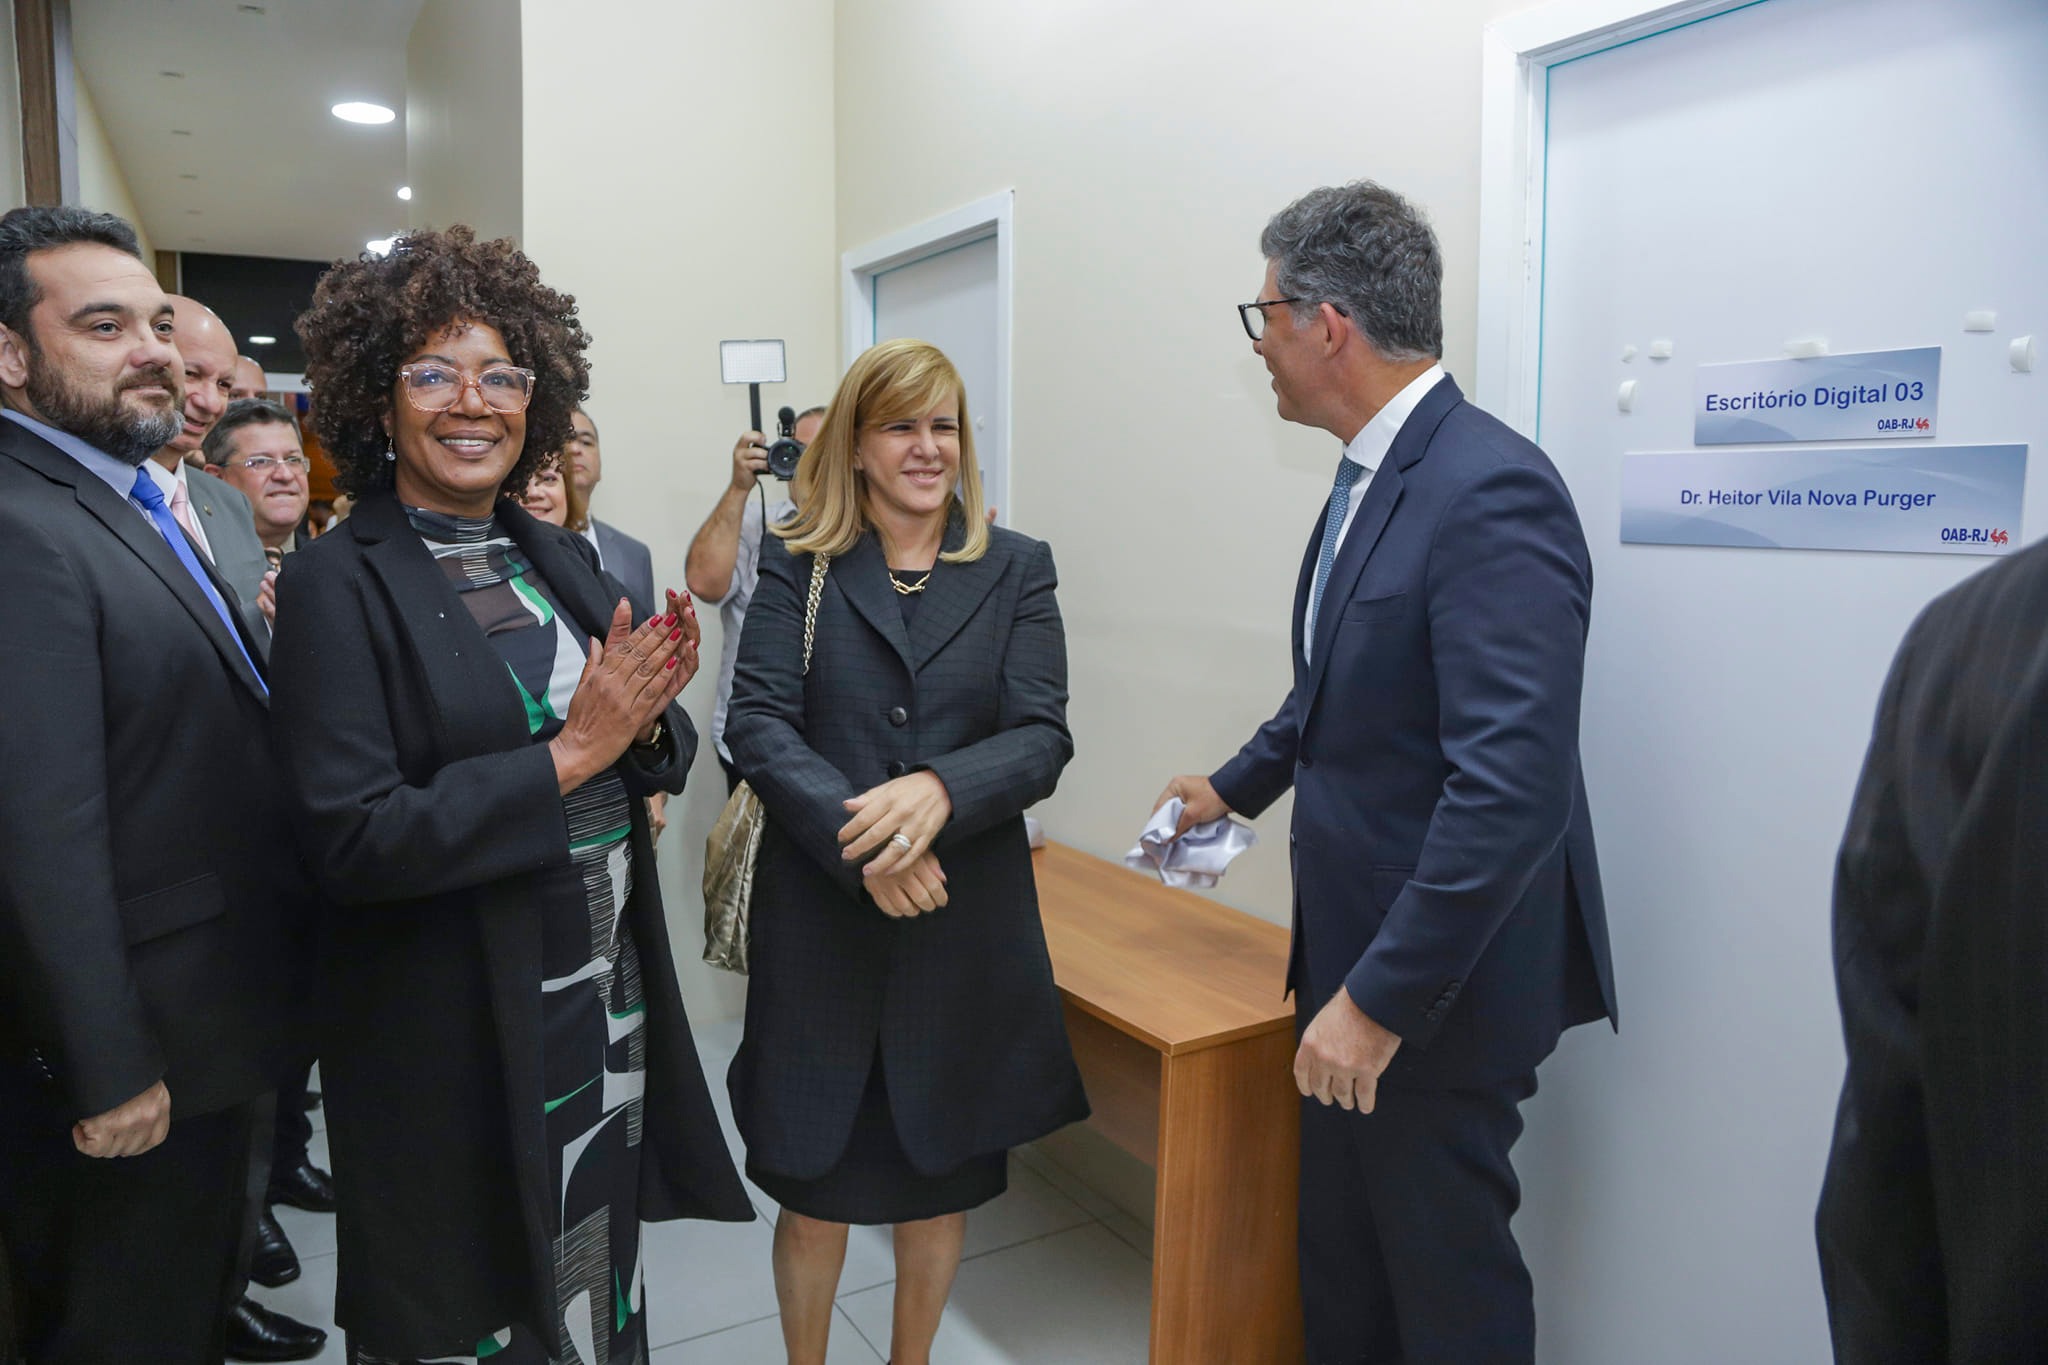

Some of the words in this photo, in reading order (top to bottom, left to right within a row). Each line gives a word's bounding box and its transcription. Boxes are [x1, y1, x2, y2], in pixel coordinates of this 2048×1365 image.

[1705, 389, 1807, 412] Escritório
[1814, 383, 1887, 408] Digital
[1894, 381, 1924, 402] 03
[1877, 418, 1914, 431] OAB-RJ
[1680, 490, 1703, 505] Dr.
[1708, 490, 1764, 506] Heitor
[1768, 490, 1802, 506] Vila
[1808, 490, 1858, 507] Nova
[1863, 489, 1937, 511] Purger
[1941, 528, 1989, 543] OAB-RJ
